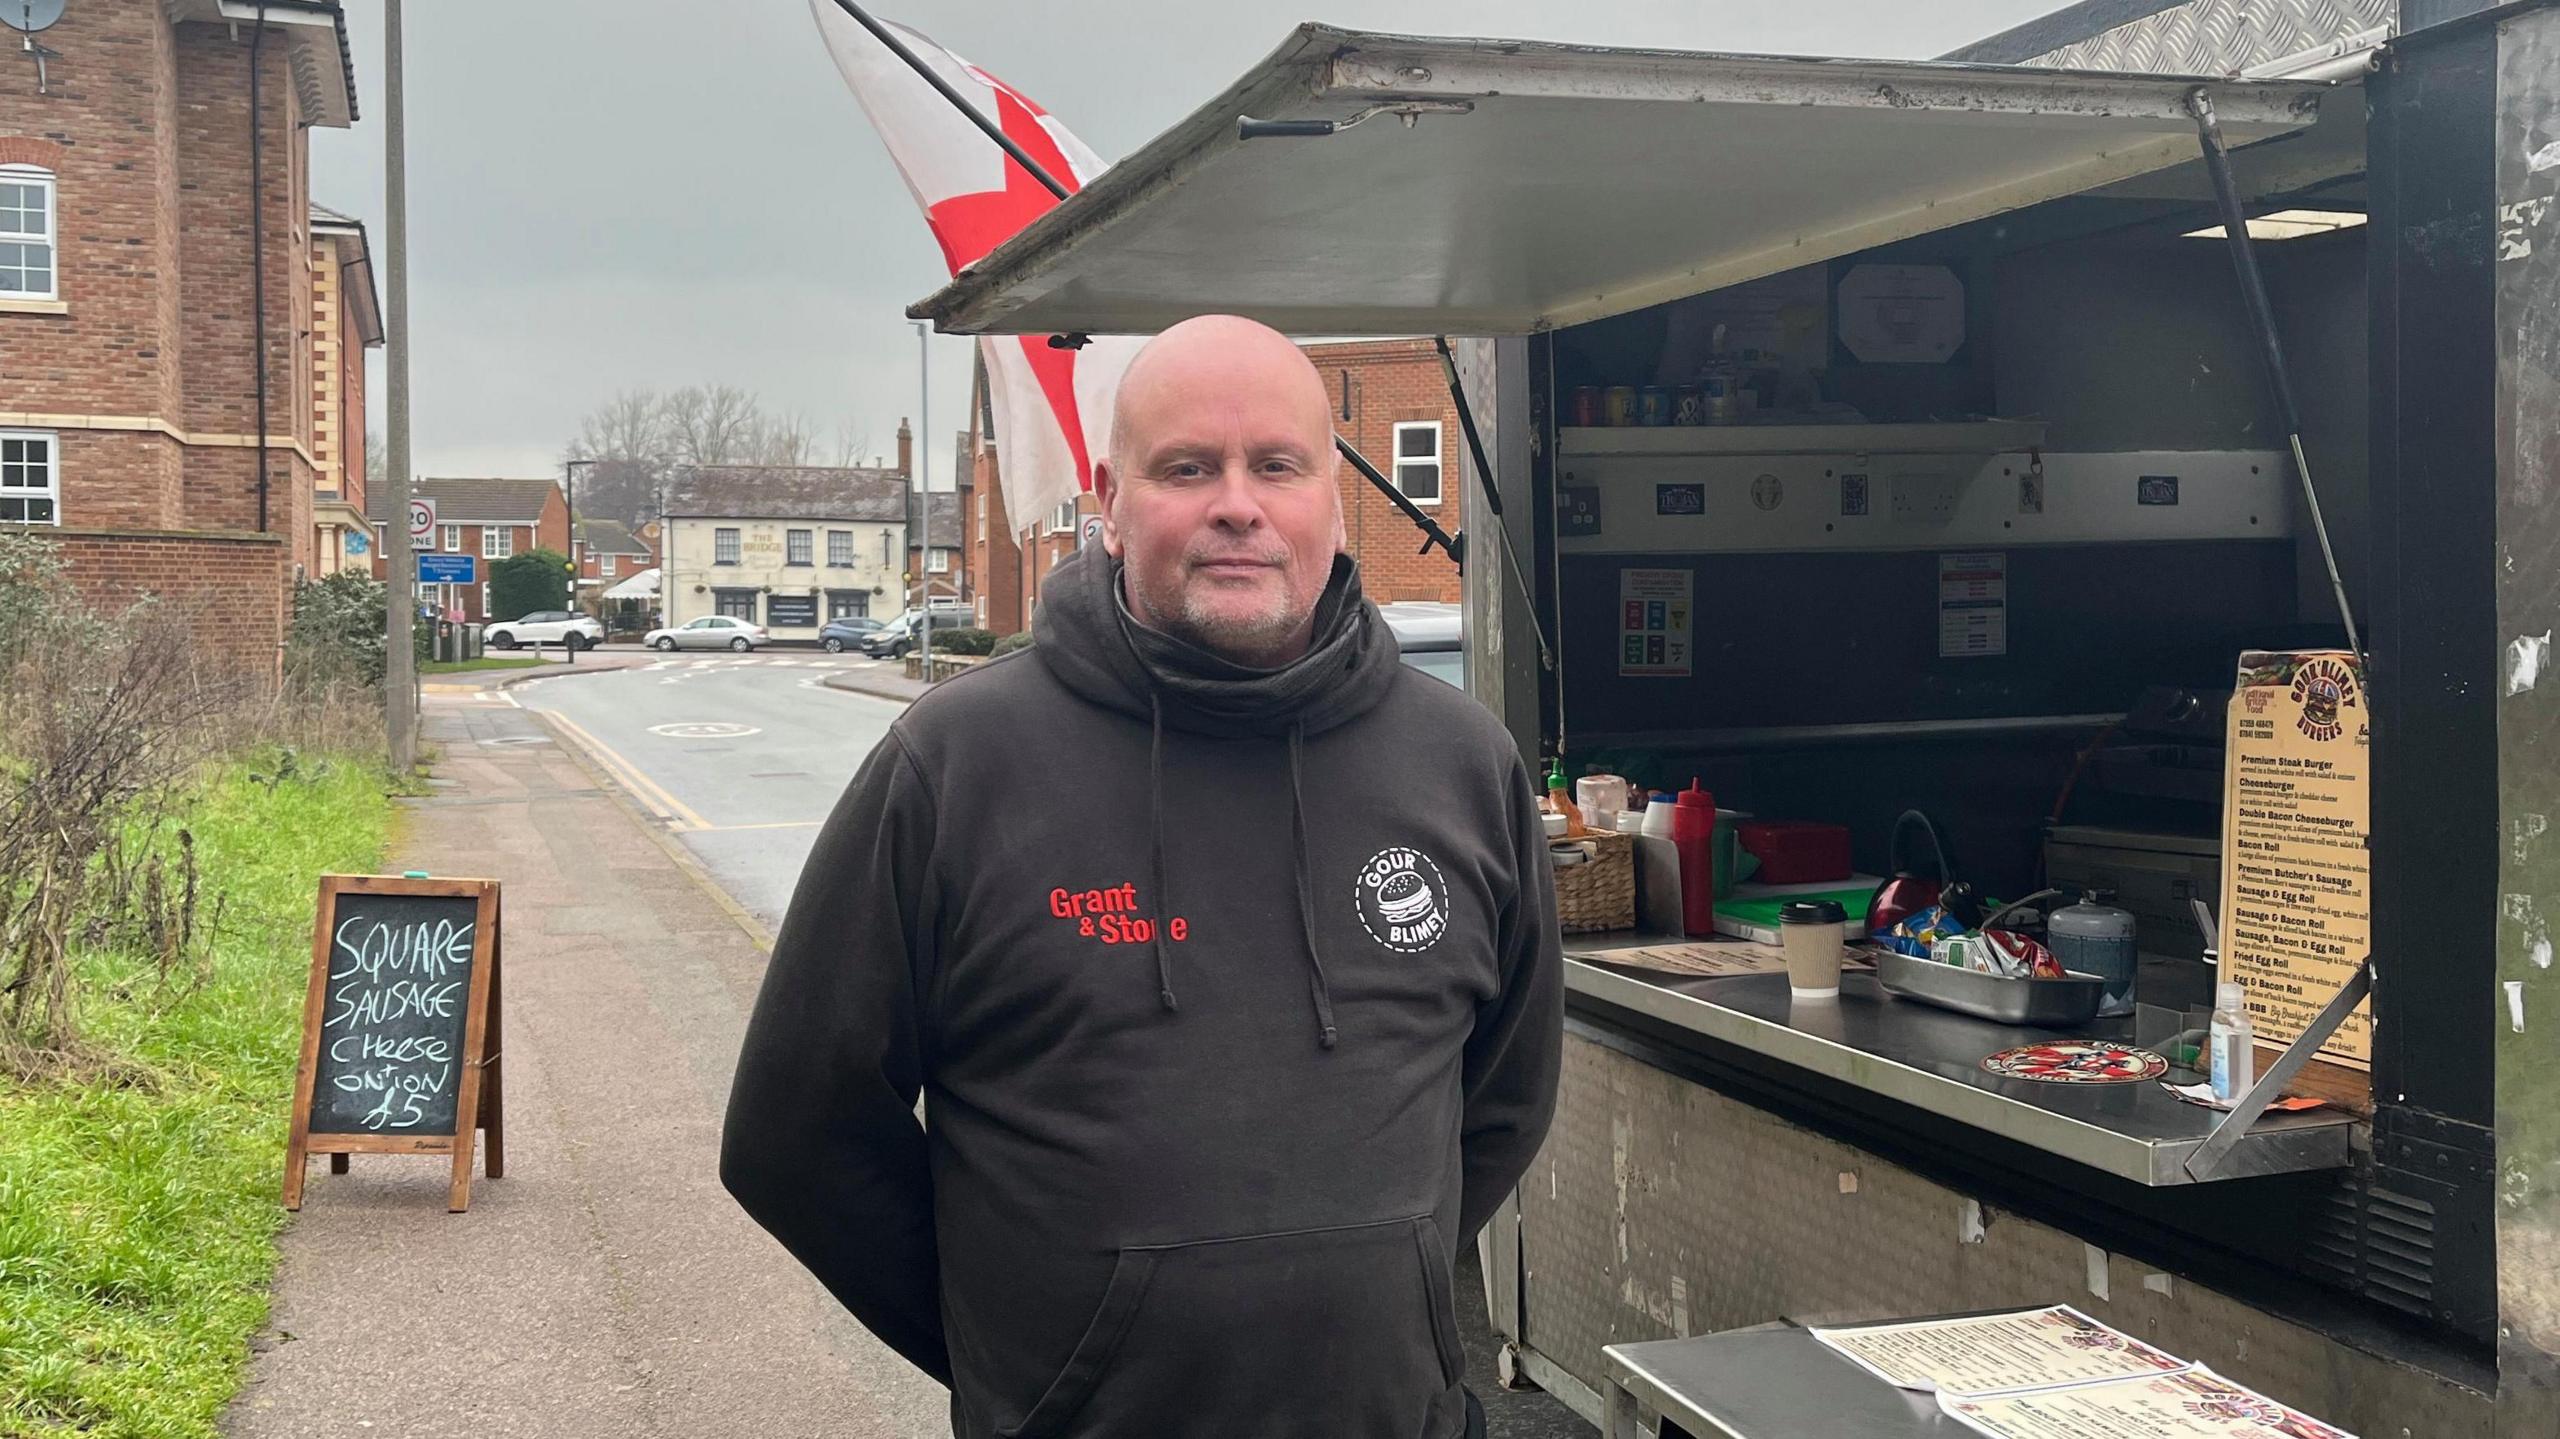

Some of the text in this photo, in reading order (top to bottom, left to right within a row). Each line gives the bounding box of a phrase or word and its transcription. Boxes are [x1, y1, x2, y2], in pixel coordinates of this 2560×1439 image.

[410, 537, 432, 546] ONE
[743, 542, 784, 553] BRIDGE
[752, 533, 773, 542] THE
[2297, 716, 2343, 742] BURGERS
[2241, 755, 2334, 771] Premium Steak Burger
[2240, 778, 2294, 792] Cheeseburger
[2240, 808, 2354, 829] Double Bacon Cheeseburger
[2238, 839, 2280, 852] Bacon Roll
[1364, 852, 1417, 889] GOUR
[2238, 864, 2353, 889] Premium Butcher's Sausage
[1049, 881, 1139, 919] Grant
[2237, 885, 2270, 899] Sausage
[2272, 890, 2279, 899] &
[2281, 891, 2298, 904] Egg
[2299, 894, 2315, 904] Roll
[1078, 916, 1096, 938] &
[1390, 906, 1446, 944] BLIMEY
[2236, 907, 2325, 930] Sausage & Bacon Roll
[331, 917, 475, 984] SQUARE
[2235, 928, 2346, 956] Sausage, Bacon & Egg Roll
[2234, 950, 2289, 969] Fried Egg Roll
[2234, 974, 2303, 996] Egg & Bacon Roll
[324, 980, 463, 1030] SAUSAGE
[2250, 1002, 2267, 1014] BBB
[360, 1087, 431, 1130] £5
